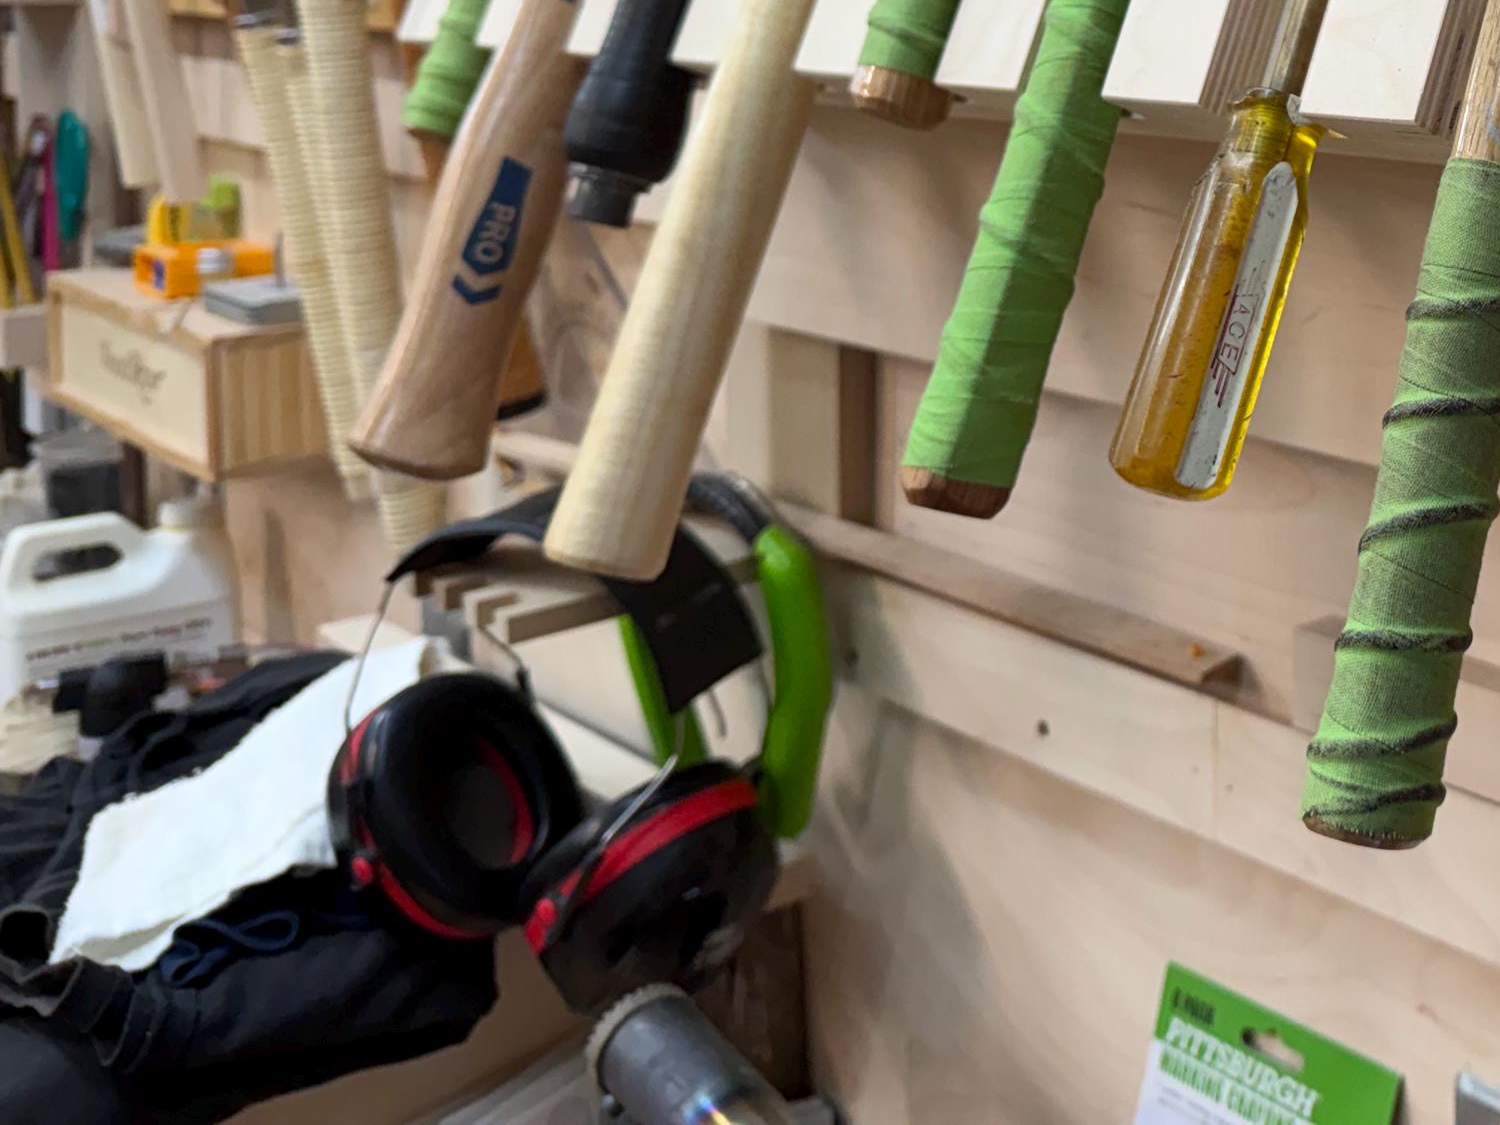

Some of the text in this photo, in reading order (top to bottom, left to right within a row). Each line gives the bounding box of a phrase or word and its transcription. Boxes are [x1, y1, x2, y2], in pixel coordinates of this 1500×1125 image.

[476, 202, 516, 265] PRO
[1220, 303, 1250, 362] ACE
[1165, 1017, 1320, 1115] PITTSBURGH
